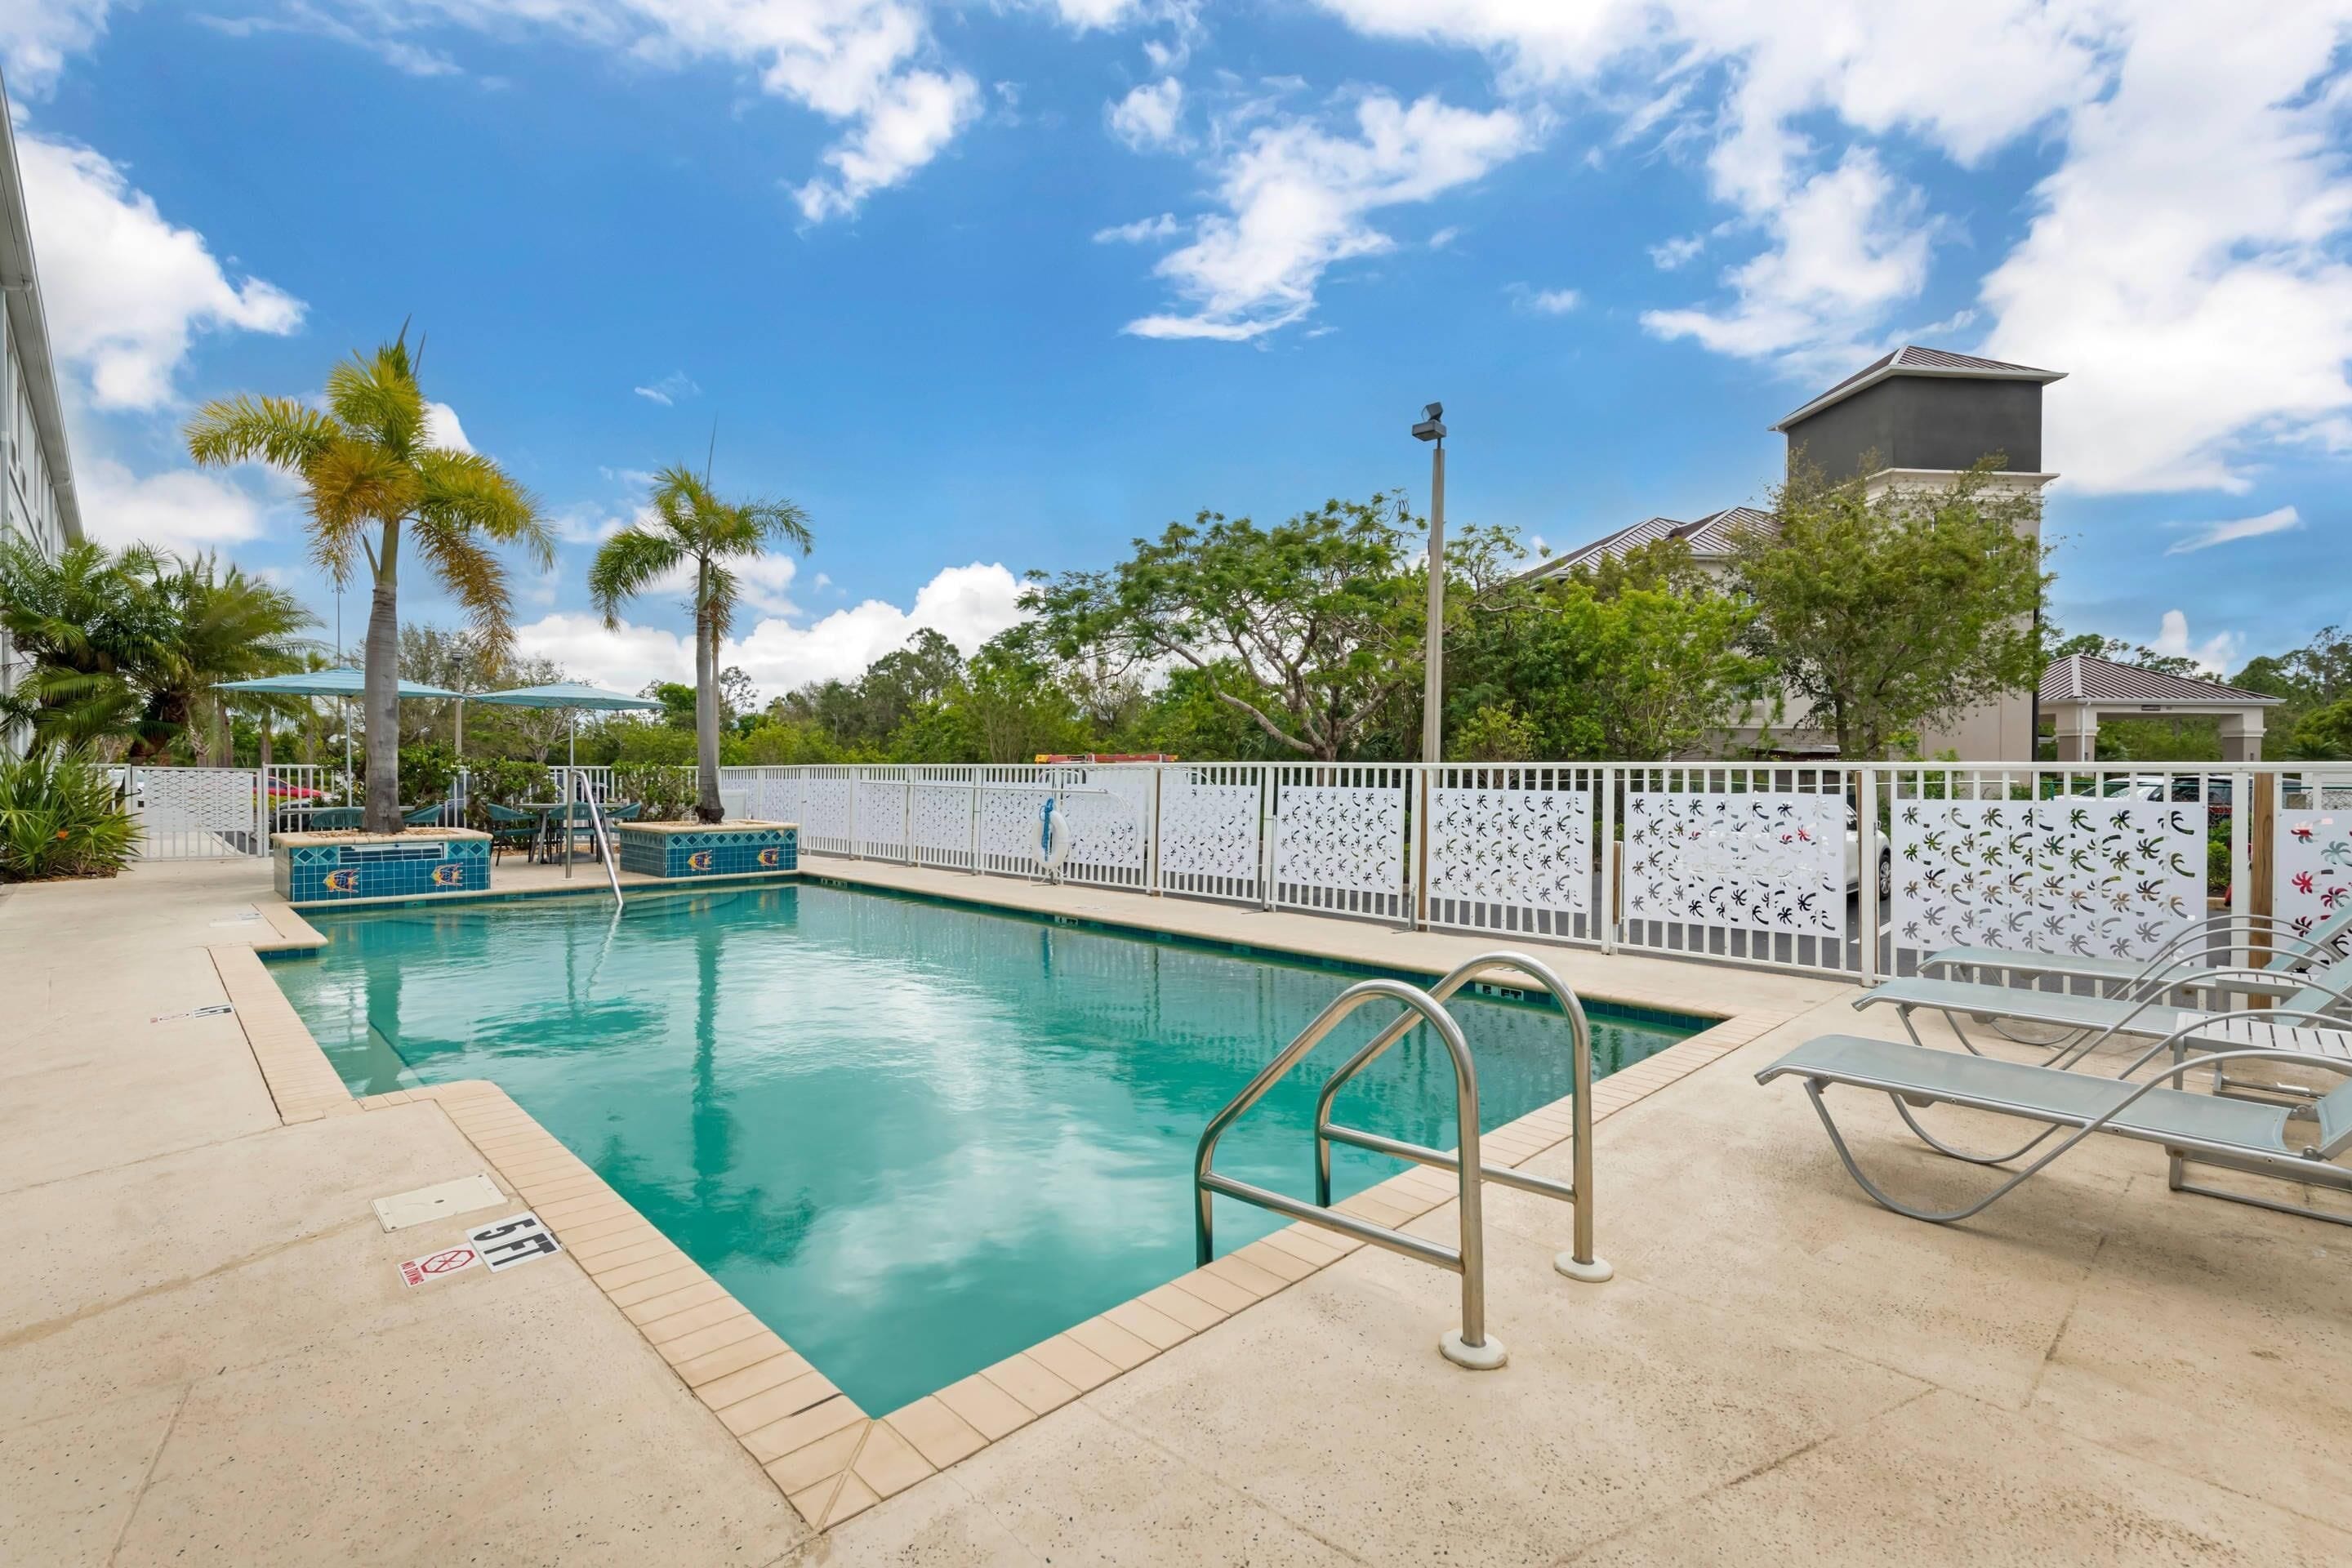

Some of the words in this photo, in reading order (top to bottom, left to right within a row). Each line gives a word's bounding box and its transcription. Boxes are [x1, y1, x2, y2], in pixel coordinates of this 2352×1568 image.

[1482, 985, 1491, 994] 5
[1501, 988, 1521, 999] FT
[474, 1218, 537, 1241] 5
[483, 1232, 558, 1267] FT
[401, 1261, 416, 1270] NO
[405, 1267, 425, 1285] DIVING
